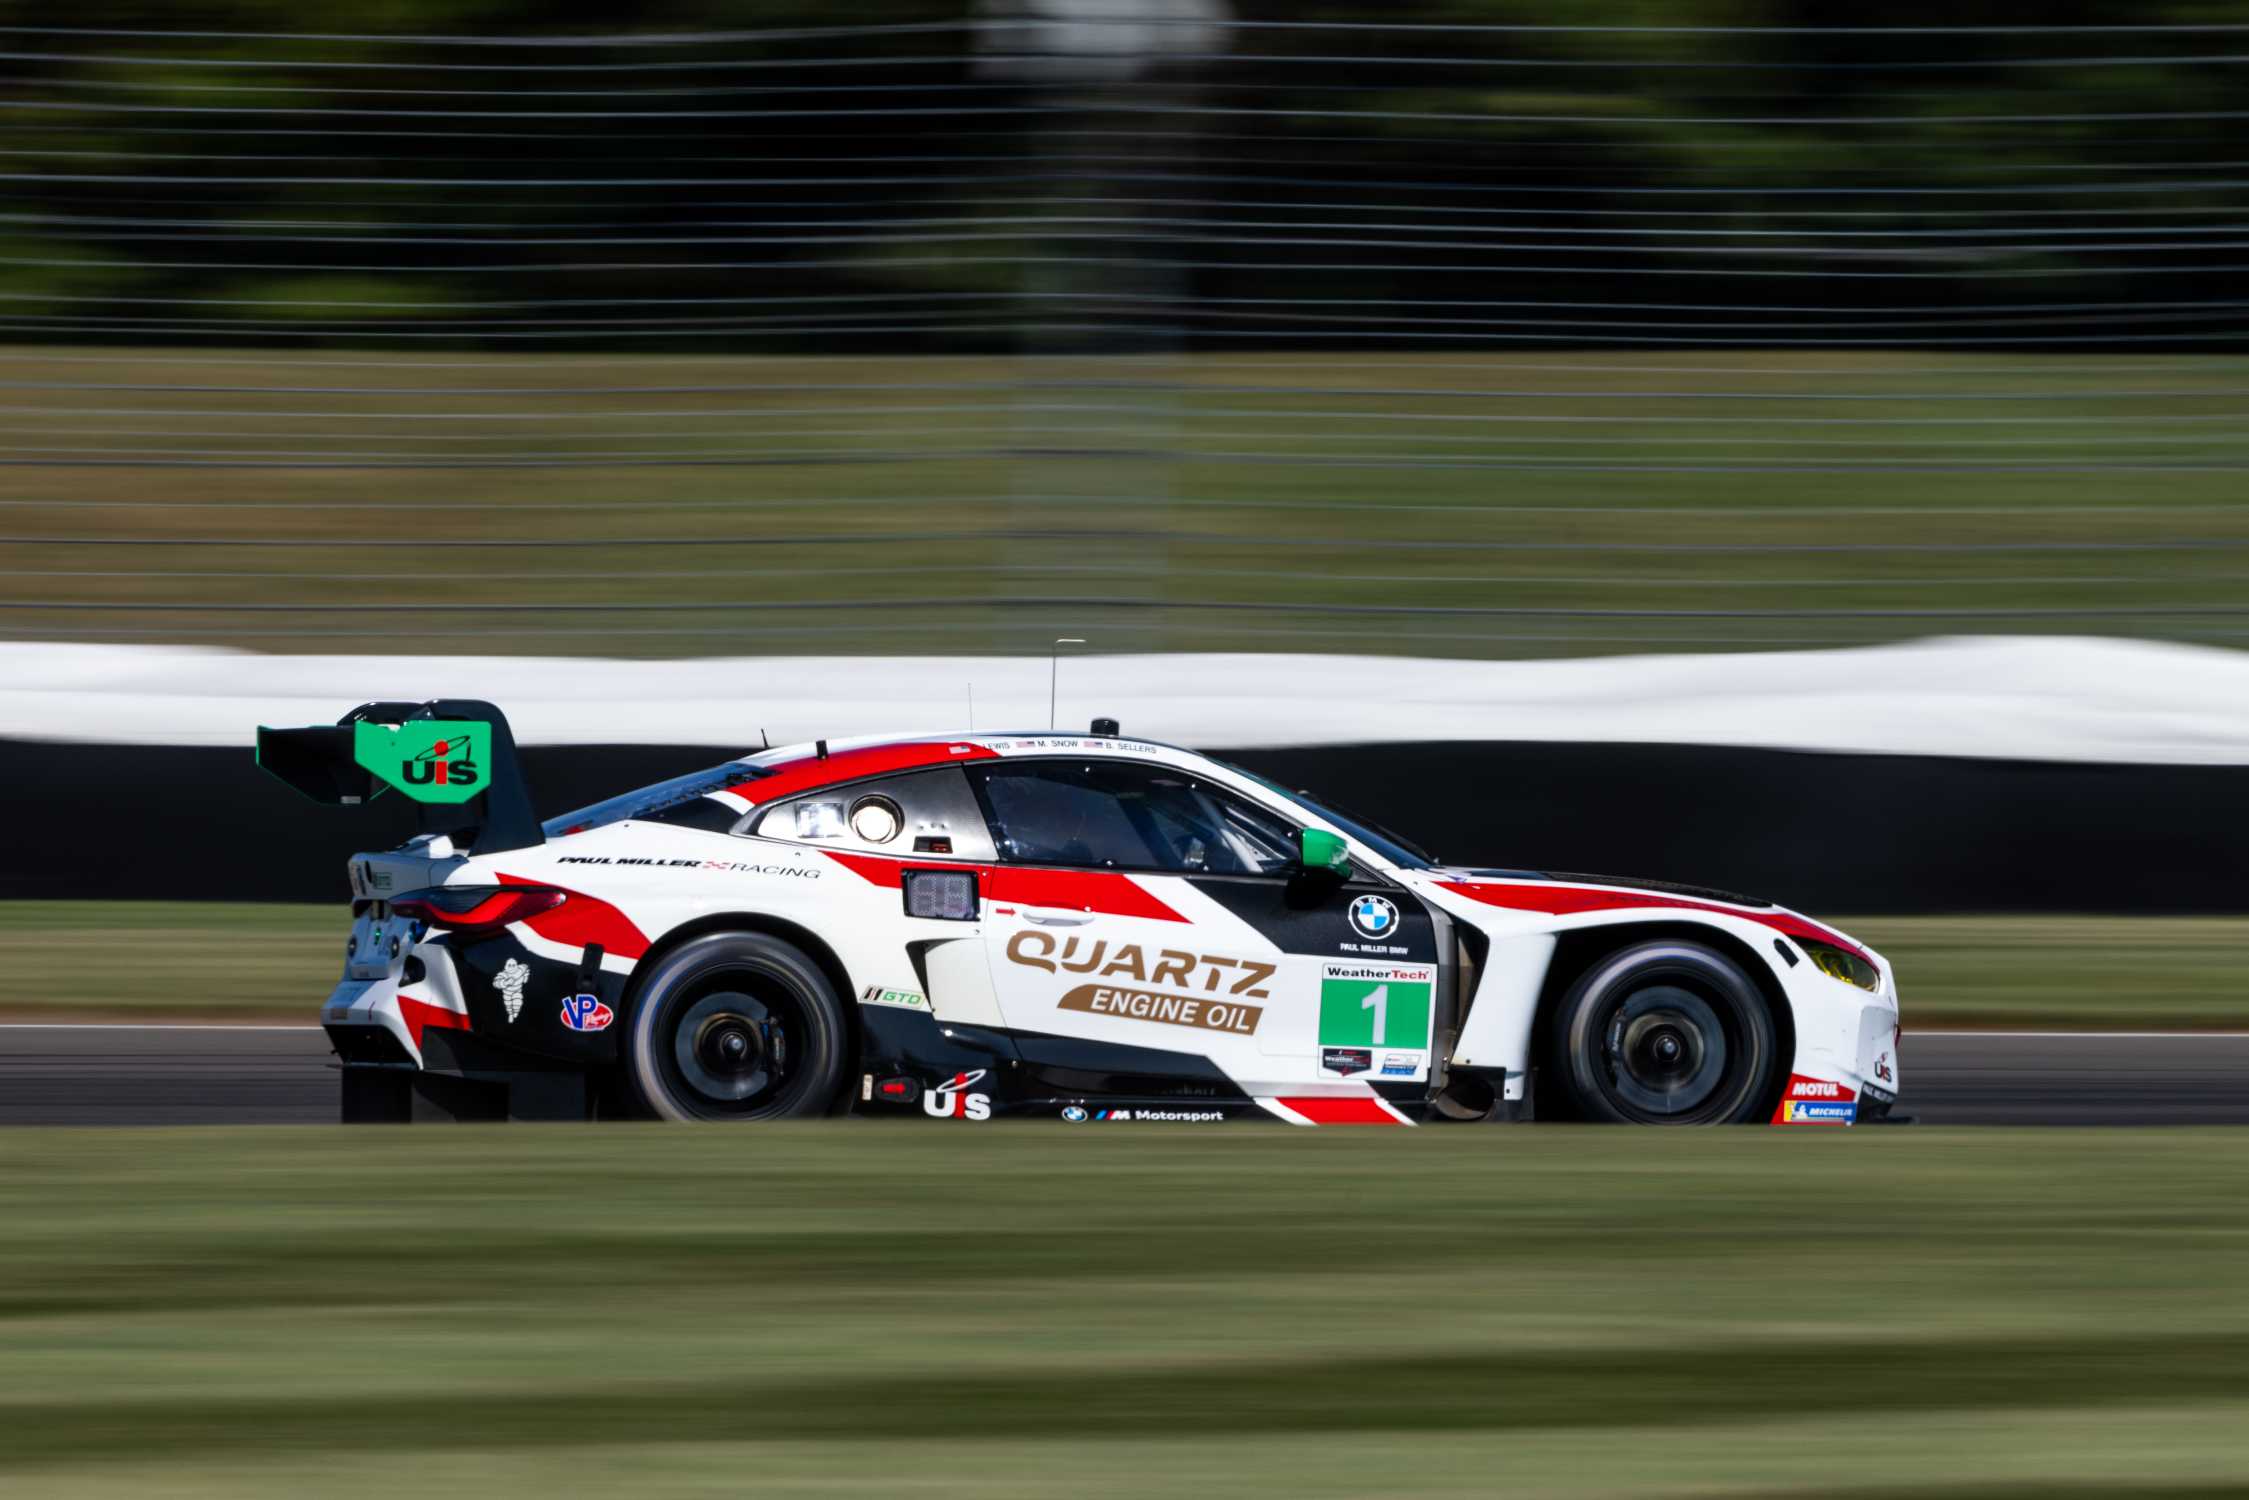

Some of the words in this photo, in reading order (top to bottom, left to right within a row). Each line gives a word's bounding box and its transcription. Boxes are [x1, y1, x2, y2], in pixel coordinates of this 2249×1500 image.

[1037, 739, 1046, 748] M.
[1051, 739, 1079, 749] SNOW
[1105, 741, 1114, 750] B.
[1118, 742, 1157, 755] SELLERS
[557, 856, 613, 866] PAUL
[616, 857, 702, 869] MILLER
[730, 862, 822, 880] RACING
[1340, 942, 1359, 952] PAUL
[1360, 943, 1388, 954] MILLER
[1389, 945, 1409, 956] BMW
[1006, 930, 1277, 999] QUARTZ
[1328, 967, 1428, 980] WeatherTech
[882, 991, 922, 1005] GTD
[562, 994, 599, 1030] VP
[1091, 988, 1200, 1024] ENGINE
[1206, 1004, 1251, 1031] OIL
[1361, 983, 1389, 1046] 1
[1792, 1082, 1839, 1097] MOTUL
[1135, 1109, 1224, 1122] Motorsport
[1809, 1107, 1853, 1117] MICHELIN
